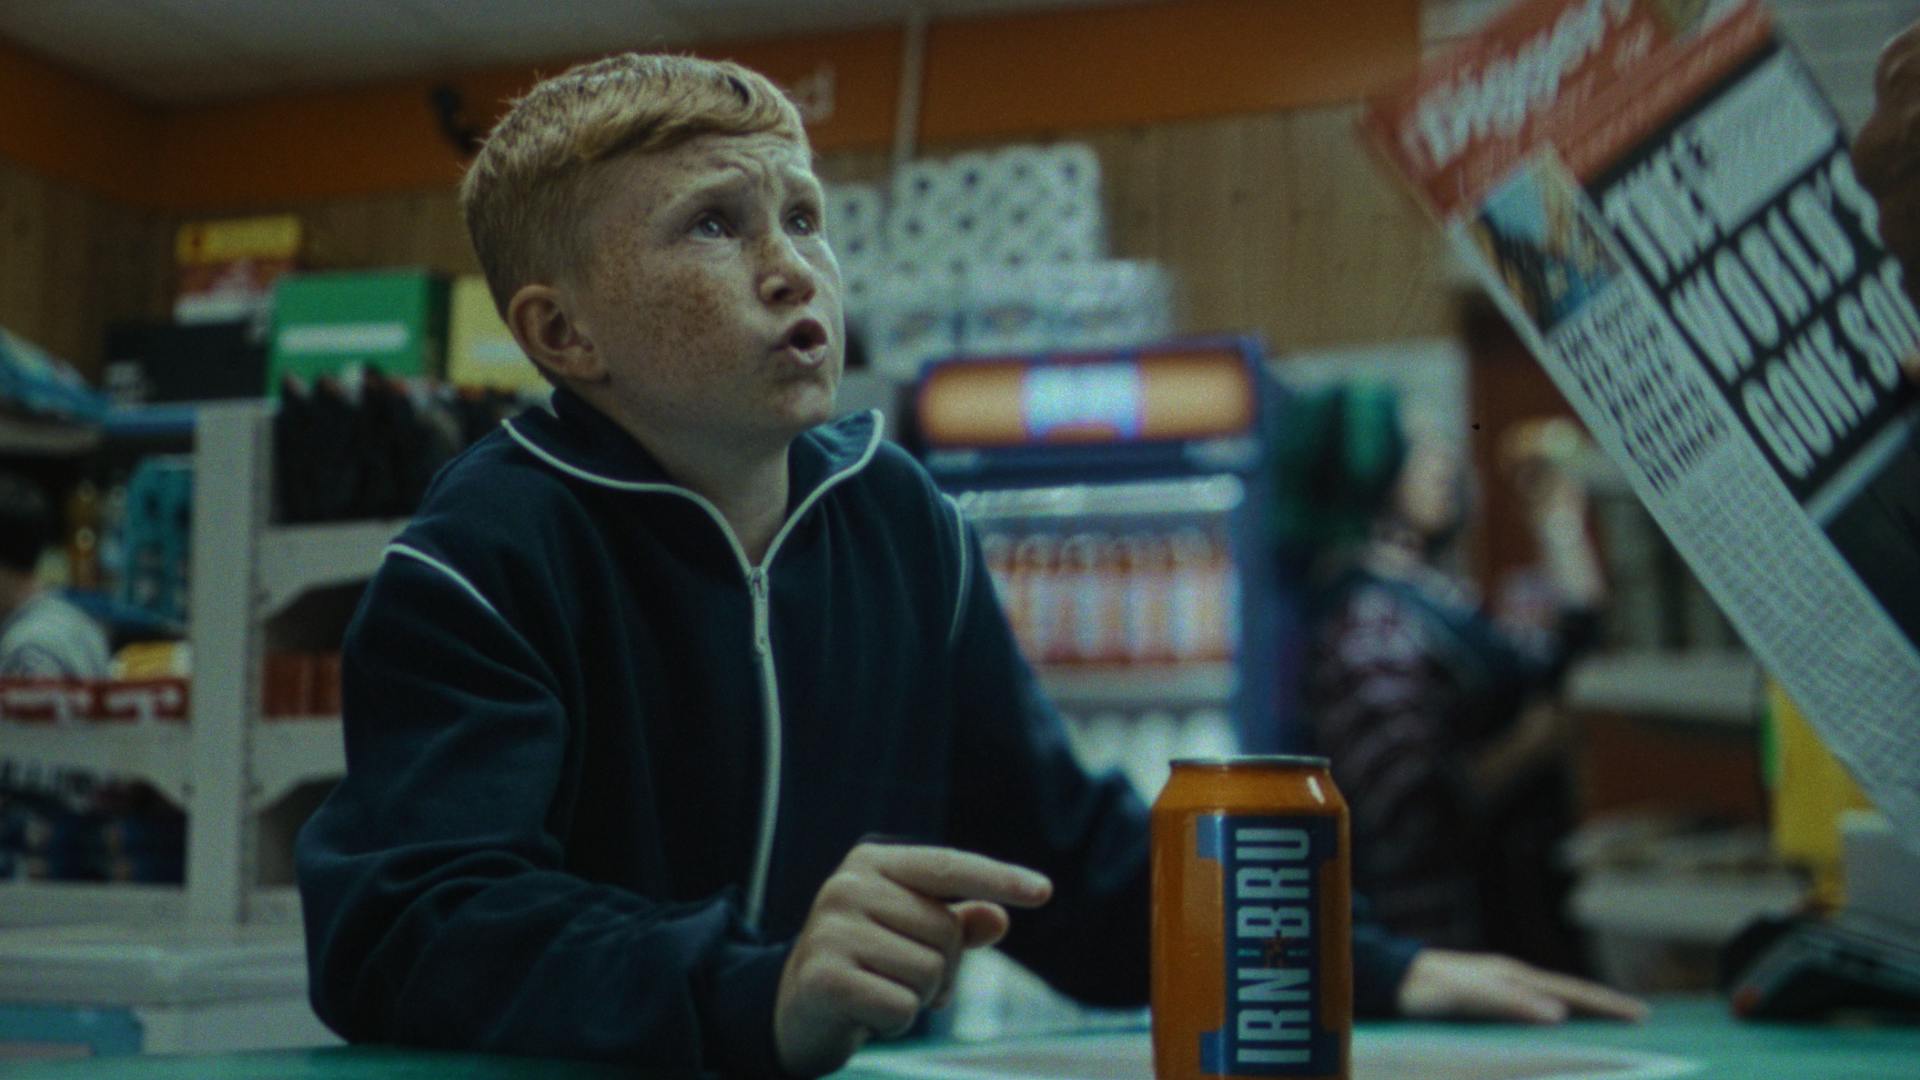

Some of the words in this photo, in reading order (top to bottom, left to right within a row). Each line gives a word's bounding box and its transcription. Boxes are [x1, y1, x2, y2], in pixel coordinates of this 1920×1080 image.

[1742, 317, 1878, 477] GONE
[1235, 827, 1311, 939] BRU
[1236, 967, 1312, 1064] IRN
